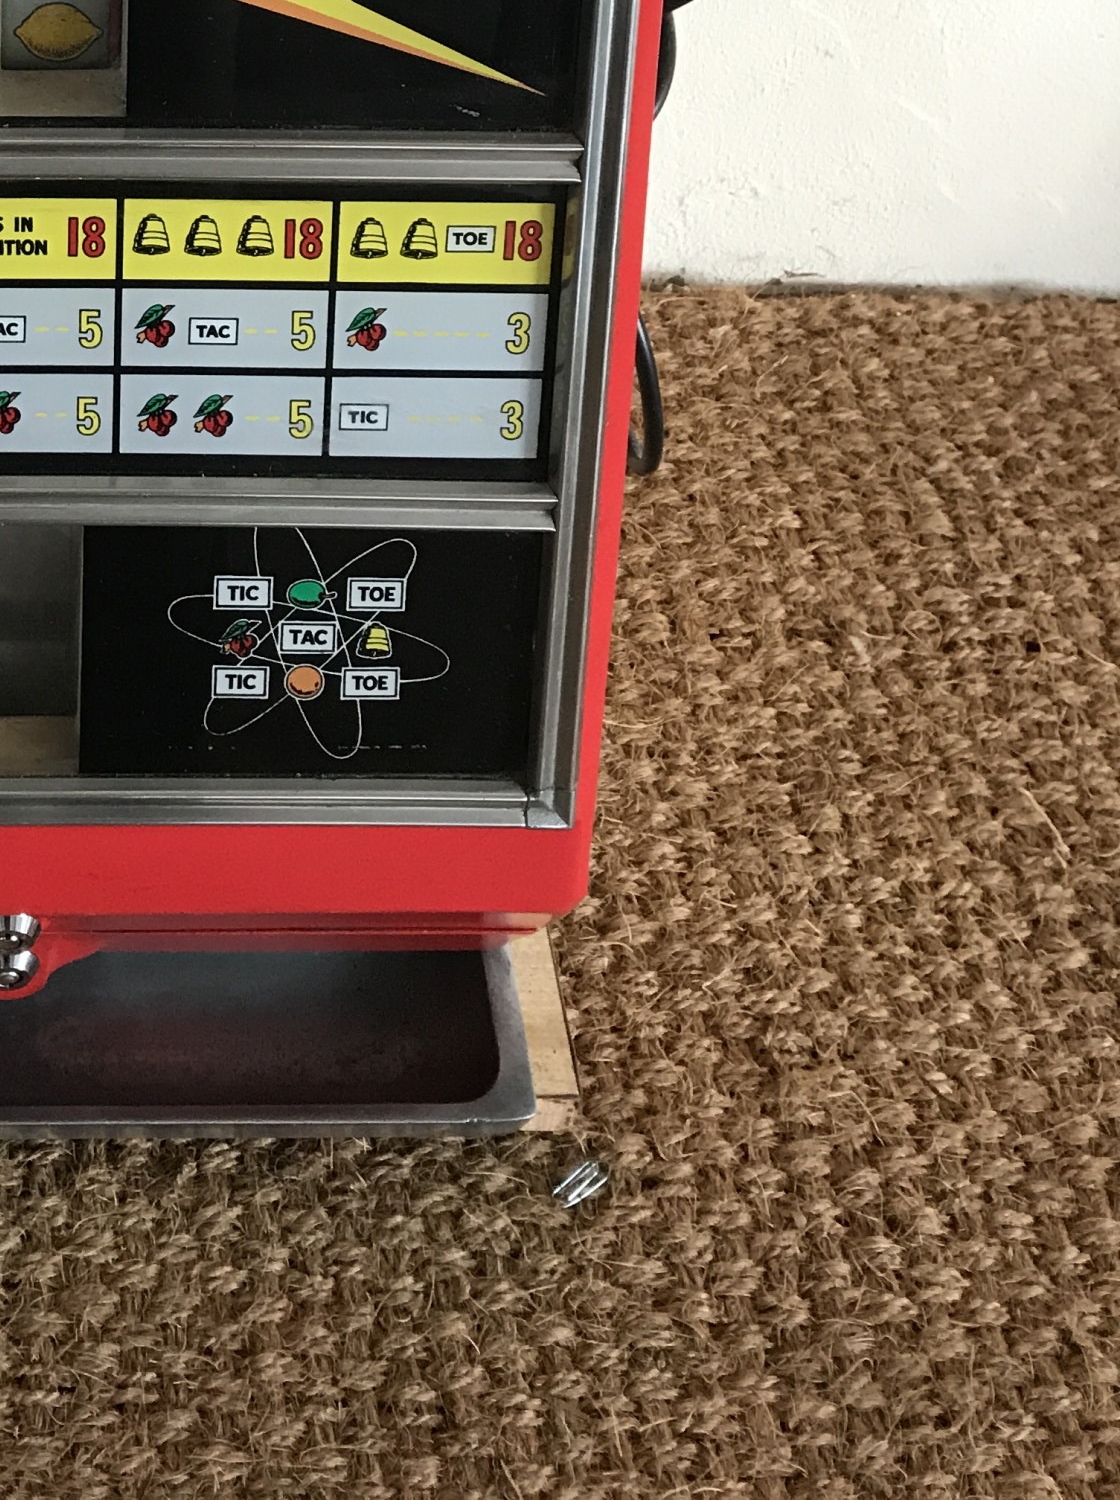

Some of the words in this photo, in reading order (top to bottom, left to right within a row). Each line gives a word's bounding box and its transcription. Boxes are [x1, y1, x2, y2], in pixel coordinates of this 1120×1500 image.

[14, 216, 33, 232] IN
[67, 216, 106, 258] 18
[283, 218, 323, 260] 18
[452, 232, 488, 246] TOE
[502, 219, 543, 262] 18
[78, 309, 103, 349] 5
[196, 324, 230, 339] TAC
[290, 310, 316, 351] 5
[505, 311, 531, 355] 3
[76, 396, 101, 436] 5
[288, 399, 314, 440] 5
[347, 410, 379, 424] TIC
[499, 399, 525, 441] 3
[227, 585, 260, 601] TIC
[357, 586, 396, 602] TOE
[289, 629, 328, 645] TAC
[225, 674, 257, 690] TIC
[351, 675, 388, 691] TOE
